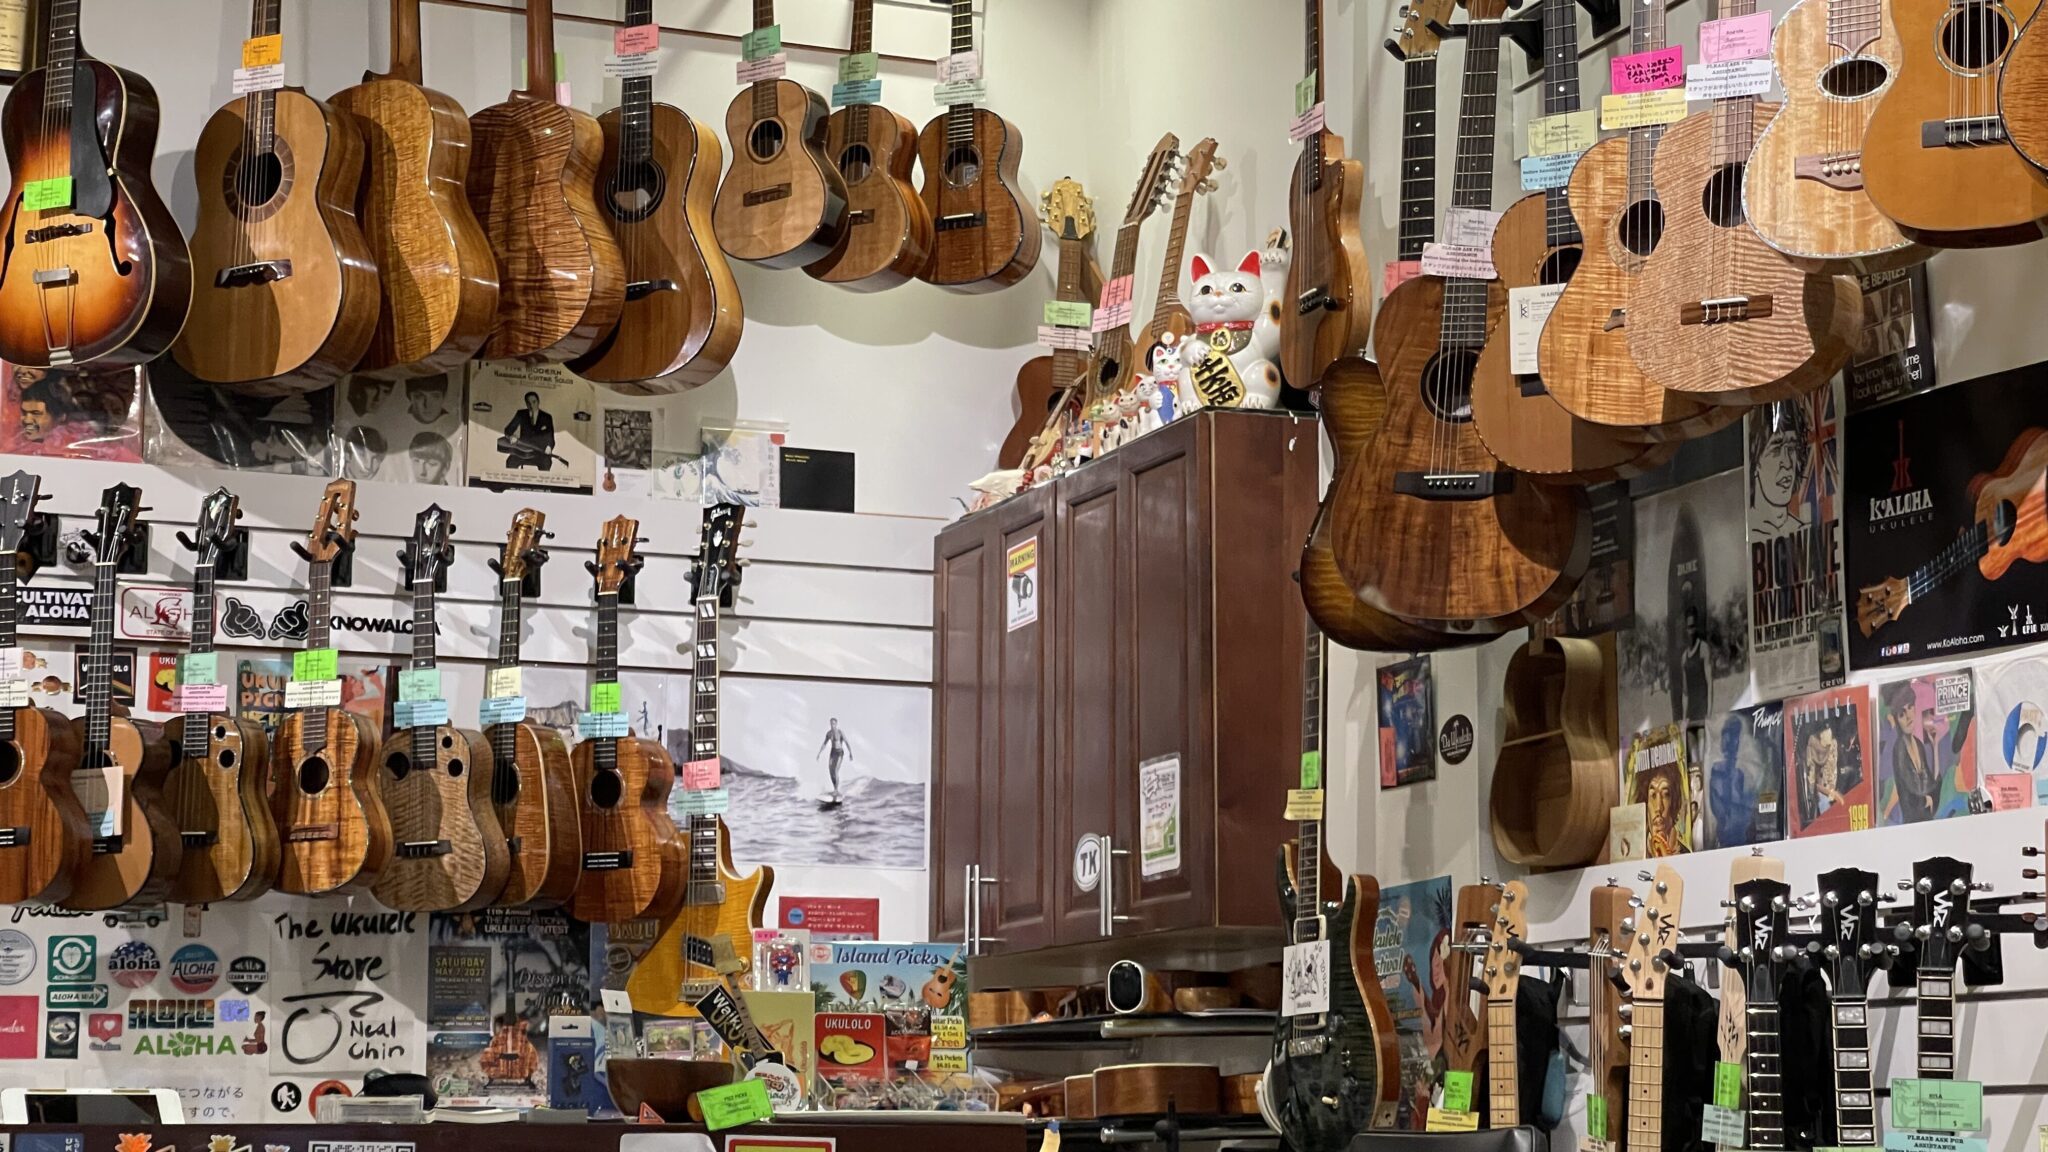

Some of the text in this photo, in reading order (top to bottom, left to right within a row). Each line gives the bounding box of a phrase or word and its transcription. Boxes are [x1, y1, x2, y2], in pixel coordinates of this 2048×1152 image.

[1869, 512, 1935, 534] UKULELE
[17, 591, 94, 606] ULTIVAT
[26, 605, 89, 619] ALOHA
[1821, 677, 1845, 689] CREW
[1937, 683, 1968, 700] PRINCE
[1752, 707, 1783, 740] Prince
[1848, 804, 1869, 832] 1999
[1080, 849, 1098, 877] TK
[275, 913, 323, 940] The
[484, 925, 569, 935] UKULELE CONTEST
[1374, 924, 1403, 948] kulele
[108, 957, 161, 971] aloha
[312, 942, 390, 982] Store
[435, 957, 485, 968] SATURDAY
[836, 947, 939, 965] Island Picks
[1375, 948, 1404, 976] stival
[81, 994, 100, 1002] WAY
[351, 1020, 397, 1040] Neal
[825, 1018, 871, 1030] UKULOLO
[349, 1042, 404, 1060] Chin
[1907, 1135, 1934, 1143] PLEASE
[1914, 1143, 1956, 1151] ASSISTANCE
